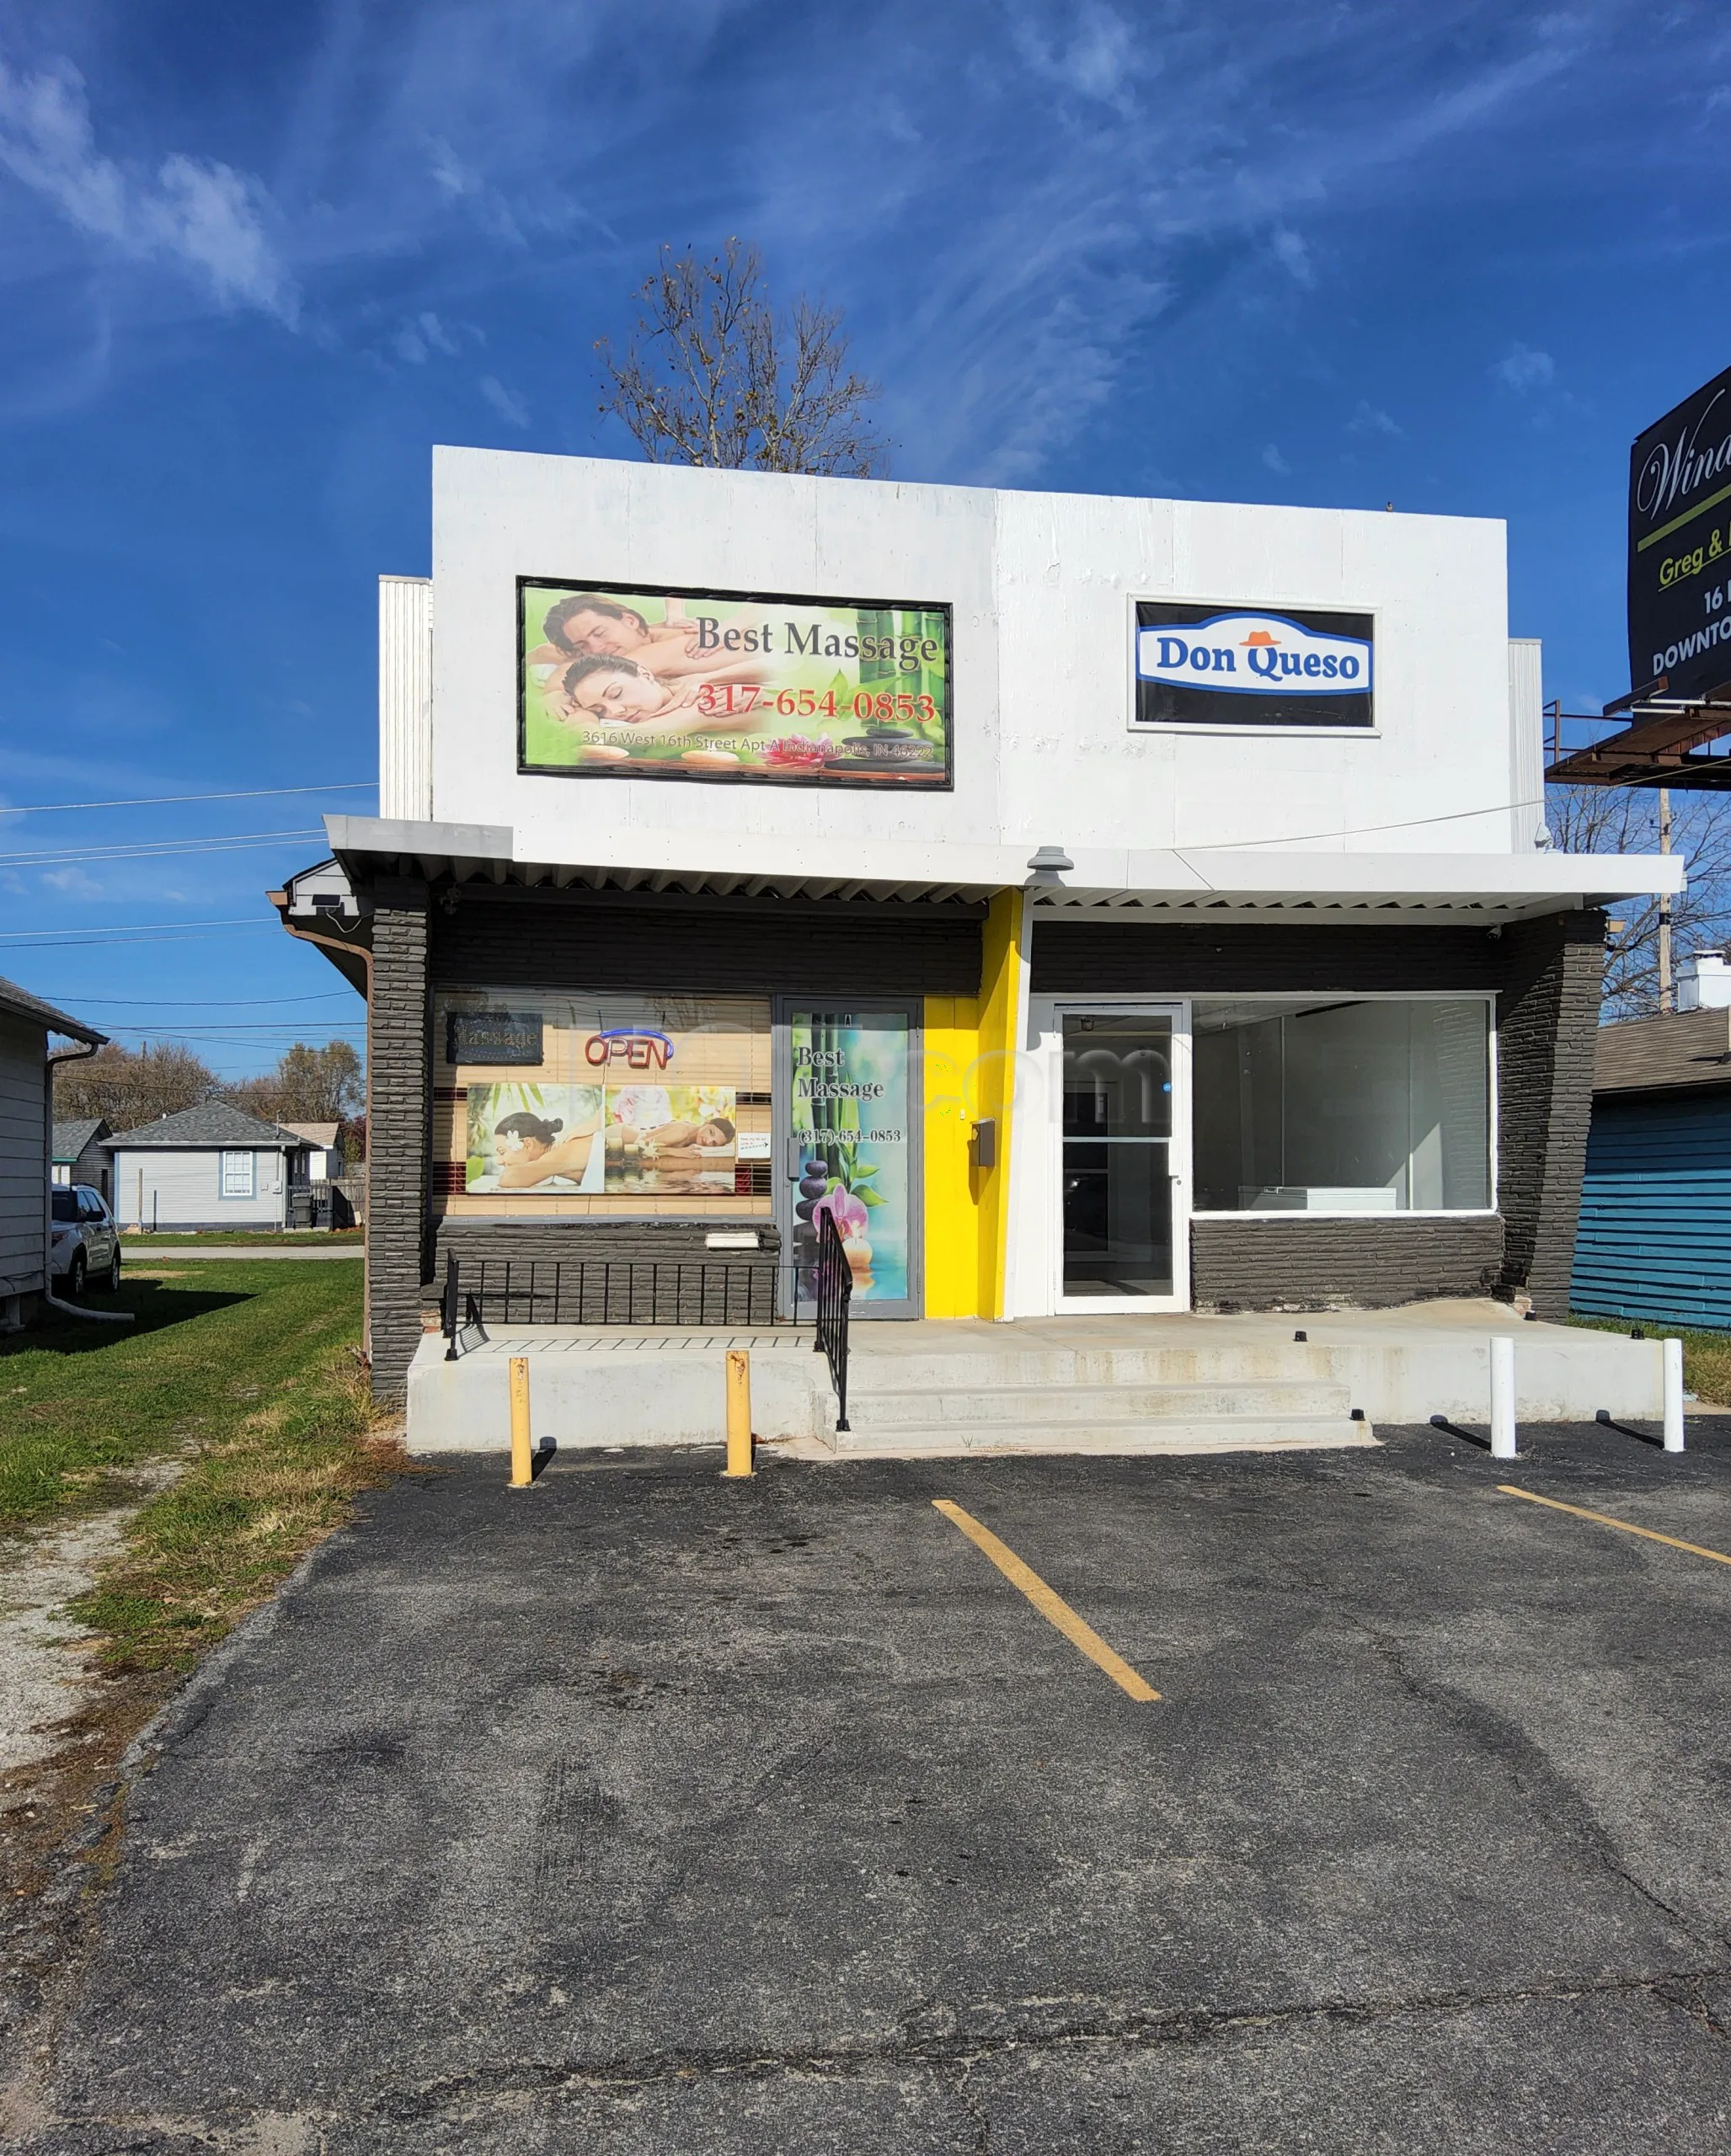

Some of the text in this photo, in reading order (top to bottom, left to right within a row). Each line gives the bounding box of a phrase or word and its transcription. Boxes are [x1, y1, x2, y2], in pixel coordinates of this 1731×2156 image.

[1659, 547, 1703, 585] Greg
[1708, 529, 1723, 558] &
[1704, 586, 1723, 614] 16
[696, 616, 938, 671] Best Massage
[1157, 637, 1360, 682] Don Queso
[697, 683, 936, 723] 317-654-0853
[582, 730, 933, 758] 3616 West 16th Street Apt A Indianapolis, IN 46222
[844, 1014, 852, 1027] A
[585, 1034, 669, 1070] OPEN
[797, 1045, 845, 1067] Best
[797, 1077, 885, 1102] Massage
